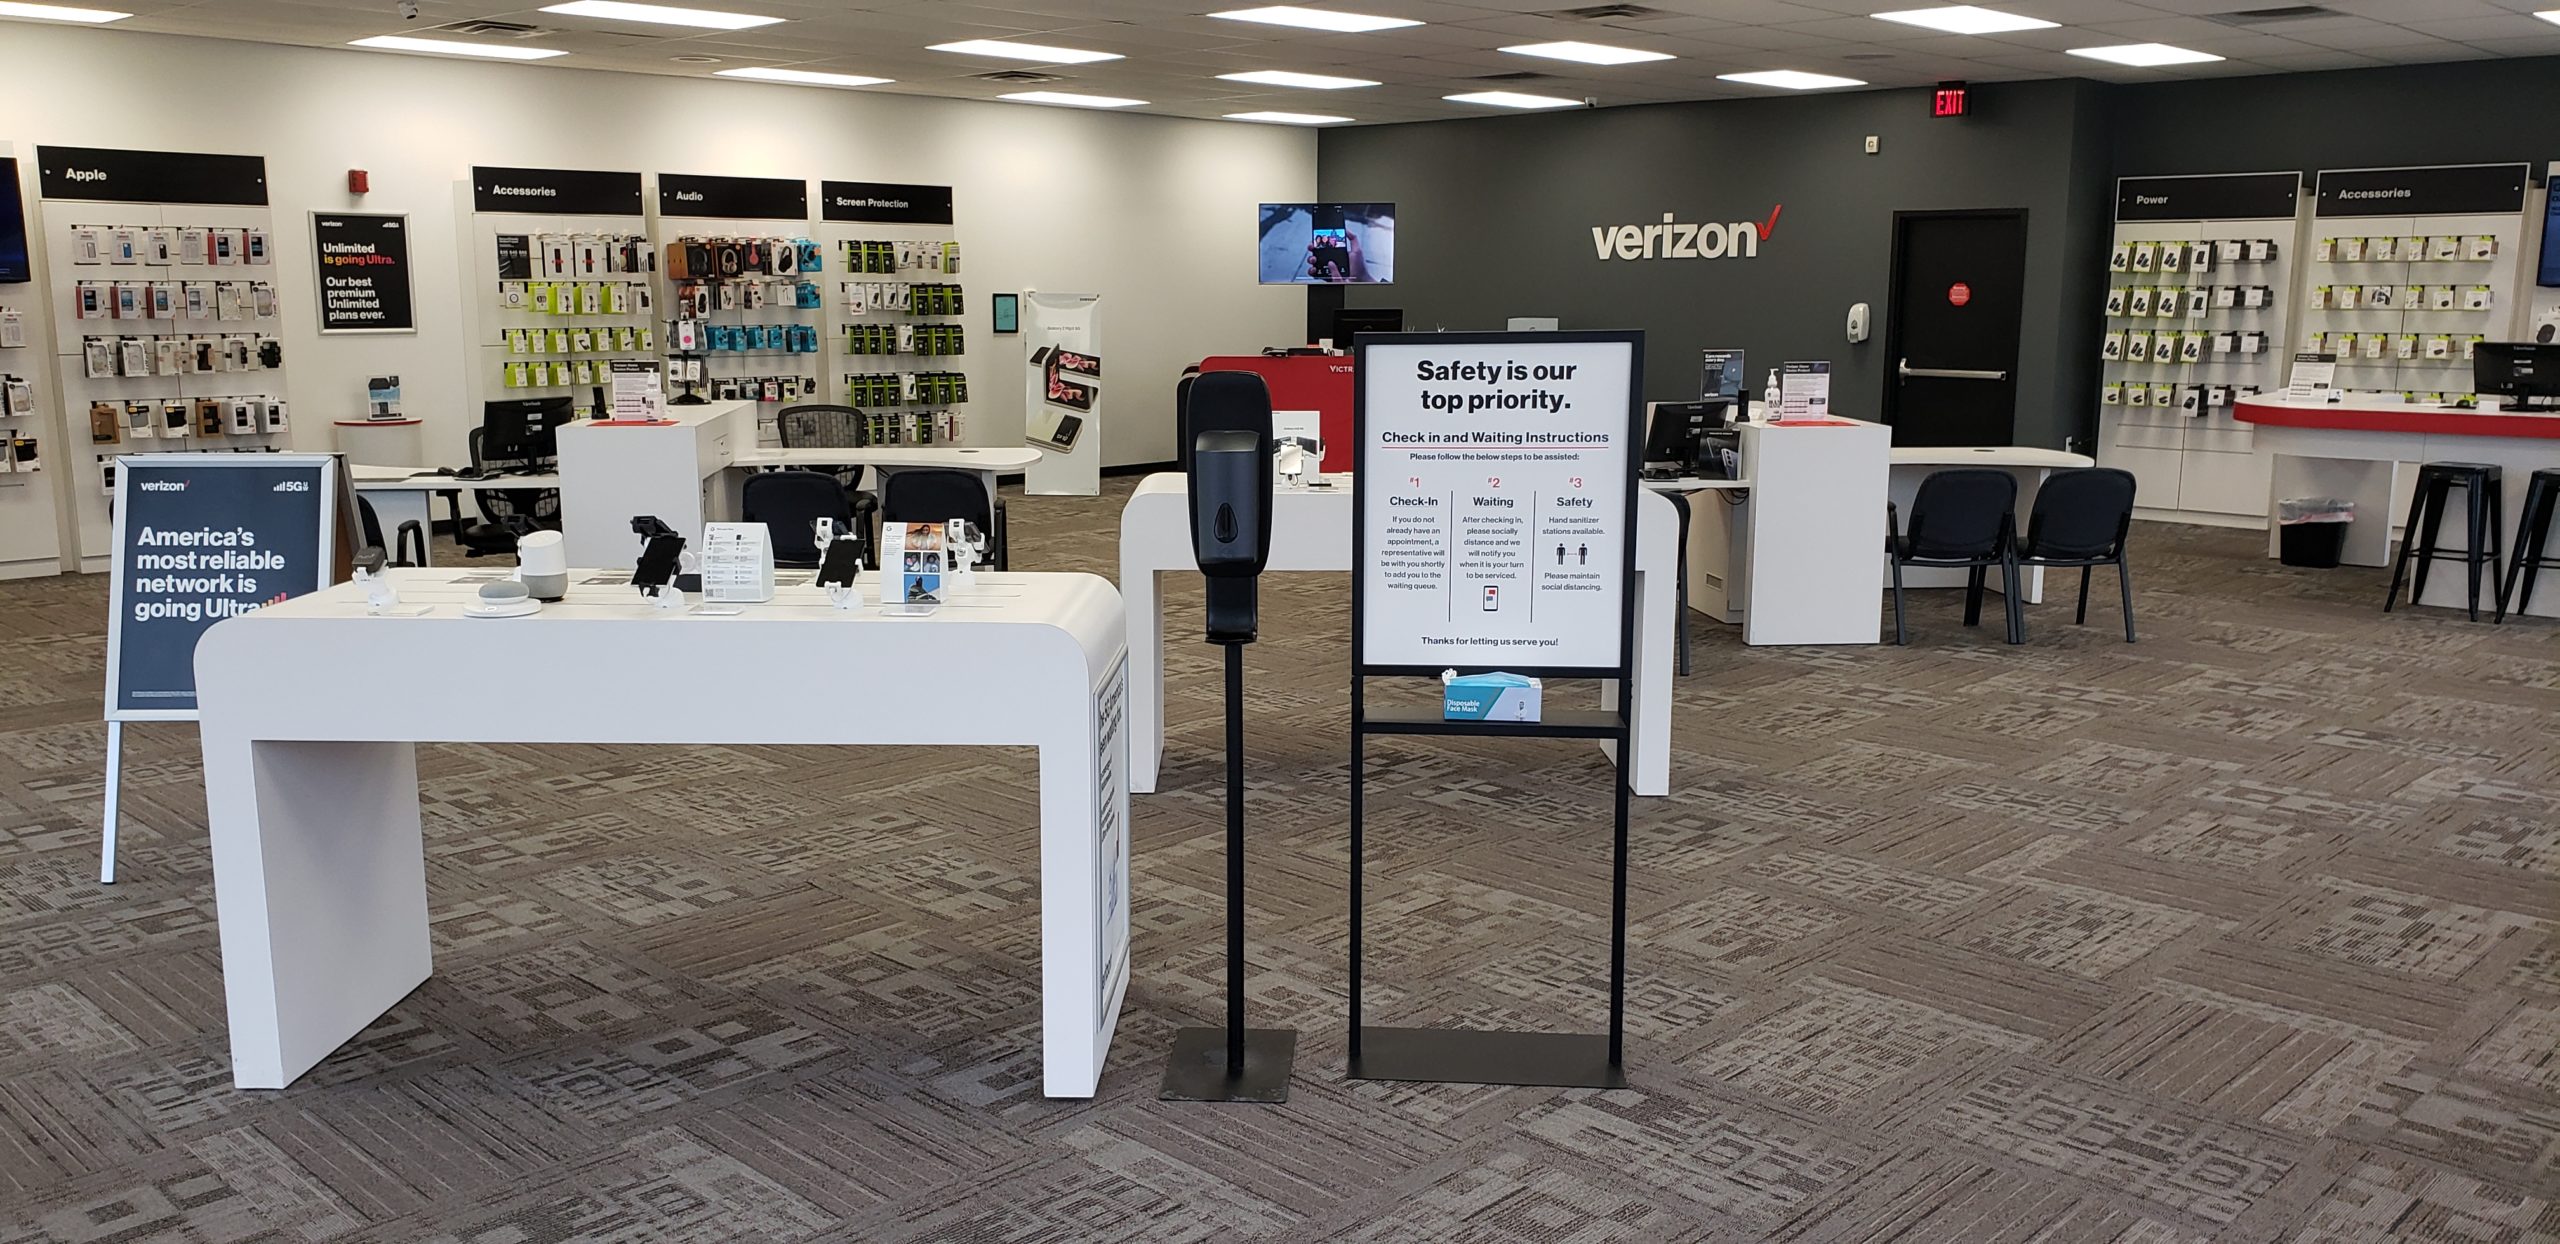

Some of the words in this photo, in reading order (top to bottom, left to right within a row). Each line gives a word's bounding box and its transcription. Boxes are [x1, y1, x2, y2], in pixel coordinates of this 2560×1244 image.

[1936, 91, 1964, 114] EXIT
[66, 168, 107, 181] Apple
[493, 185, 556, 196] Accessories
[676, 191, 703, 201] Audio
[2339, 188, 2411, 200] Accessories
[837, 197, 866, 207] Screen
[868, 198, 908, 208] Protection
[2136, 195, 2168, 205] Power
[1592, 212, 1757, 260] verizon
[323, 243, 375, 253] Unlimited
[324, 254, 334, 264] is
[335, 255, 365, 266] going
[366, 255, 395, 264] Ultra.
[326, 277, 346, 286] Our
[348, 277, 372, 286] best
[327, 288, 375, 298] premium
[328, 299, 380, 308] Unlimited
[329, 310, 358, 321] plans
[1417, 360, 1502, 385] Safety
[1507, 360, 1528, 380] is
[1533, 365, 1577, 380] our
[1421, 390, 1463, 413] top
[1468, 389, 1571, 413] priority.
[1382, 432, 1425, 443] Check
[1428, 432, 1440, 442] in
[1444, 432, 1468, 442] and
[1472, 432, 1522, 444] Waiting
[1526, 432, 1609, 443] Instructions
[1501, 454, 1522, 462] steps
[141, 481, 184, 491] verizon
[1410, 477, 1420, 488] #1
[1488, 477, 1500, 488] #2
[1569, 477, 1582, 488] #3
[1390, 496, 1438, 506] Check-In
[1473, 497, 1514, 508] Waiting
[1557, 497, 1593, 508] Safety
[137, 526, 254, 547] America's
[1386, 527, 1412, 536] already
[1387, 538, 1434, 547] appointment,
[1382, 550, 1432, 558] representative
[1481, 550, 1501, 558] notify
[137, 552, 196, 570] most
[200, 550, 285, 570] reliable
[1421, 560, 1445, 569] shortly
[136, 574, 233, 593] network
[238, 574, 257, 593] is
[1388, 582, 1413, 590] waiting
[1563, 584, 1602, 592] distancing.
[135, 598, 200, 622] going
[1422, 637, 1454, 645] Thanks
[1456, 637, 1469, 645] for
[1470, 637, 1498, 646] letting
[1539, 638, 1558, 647] you!
